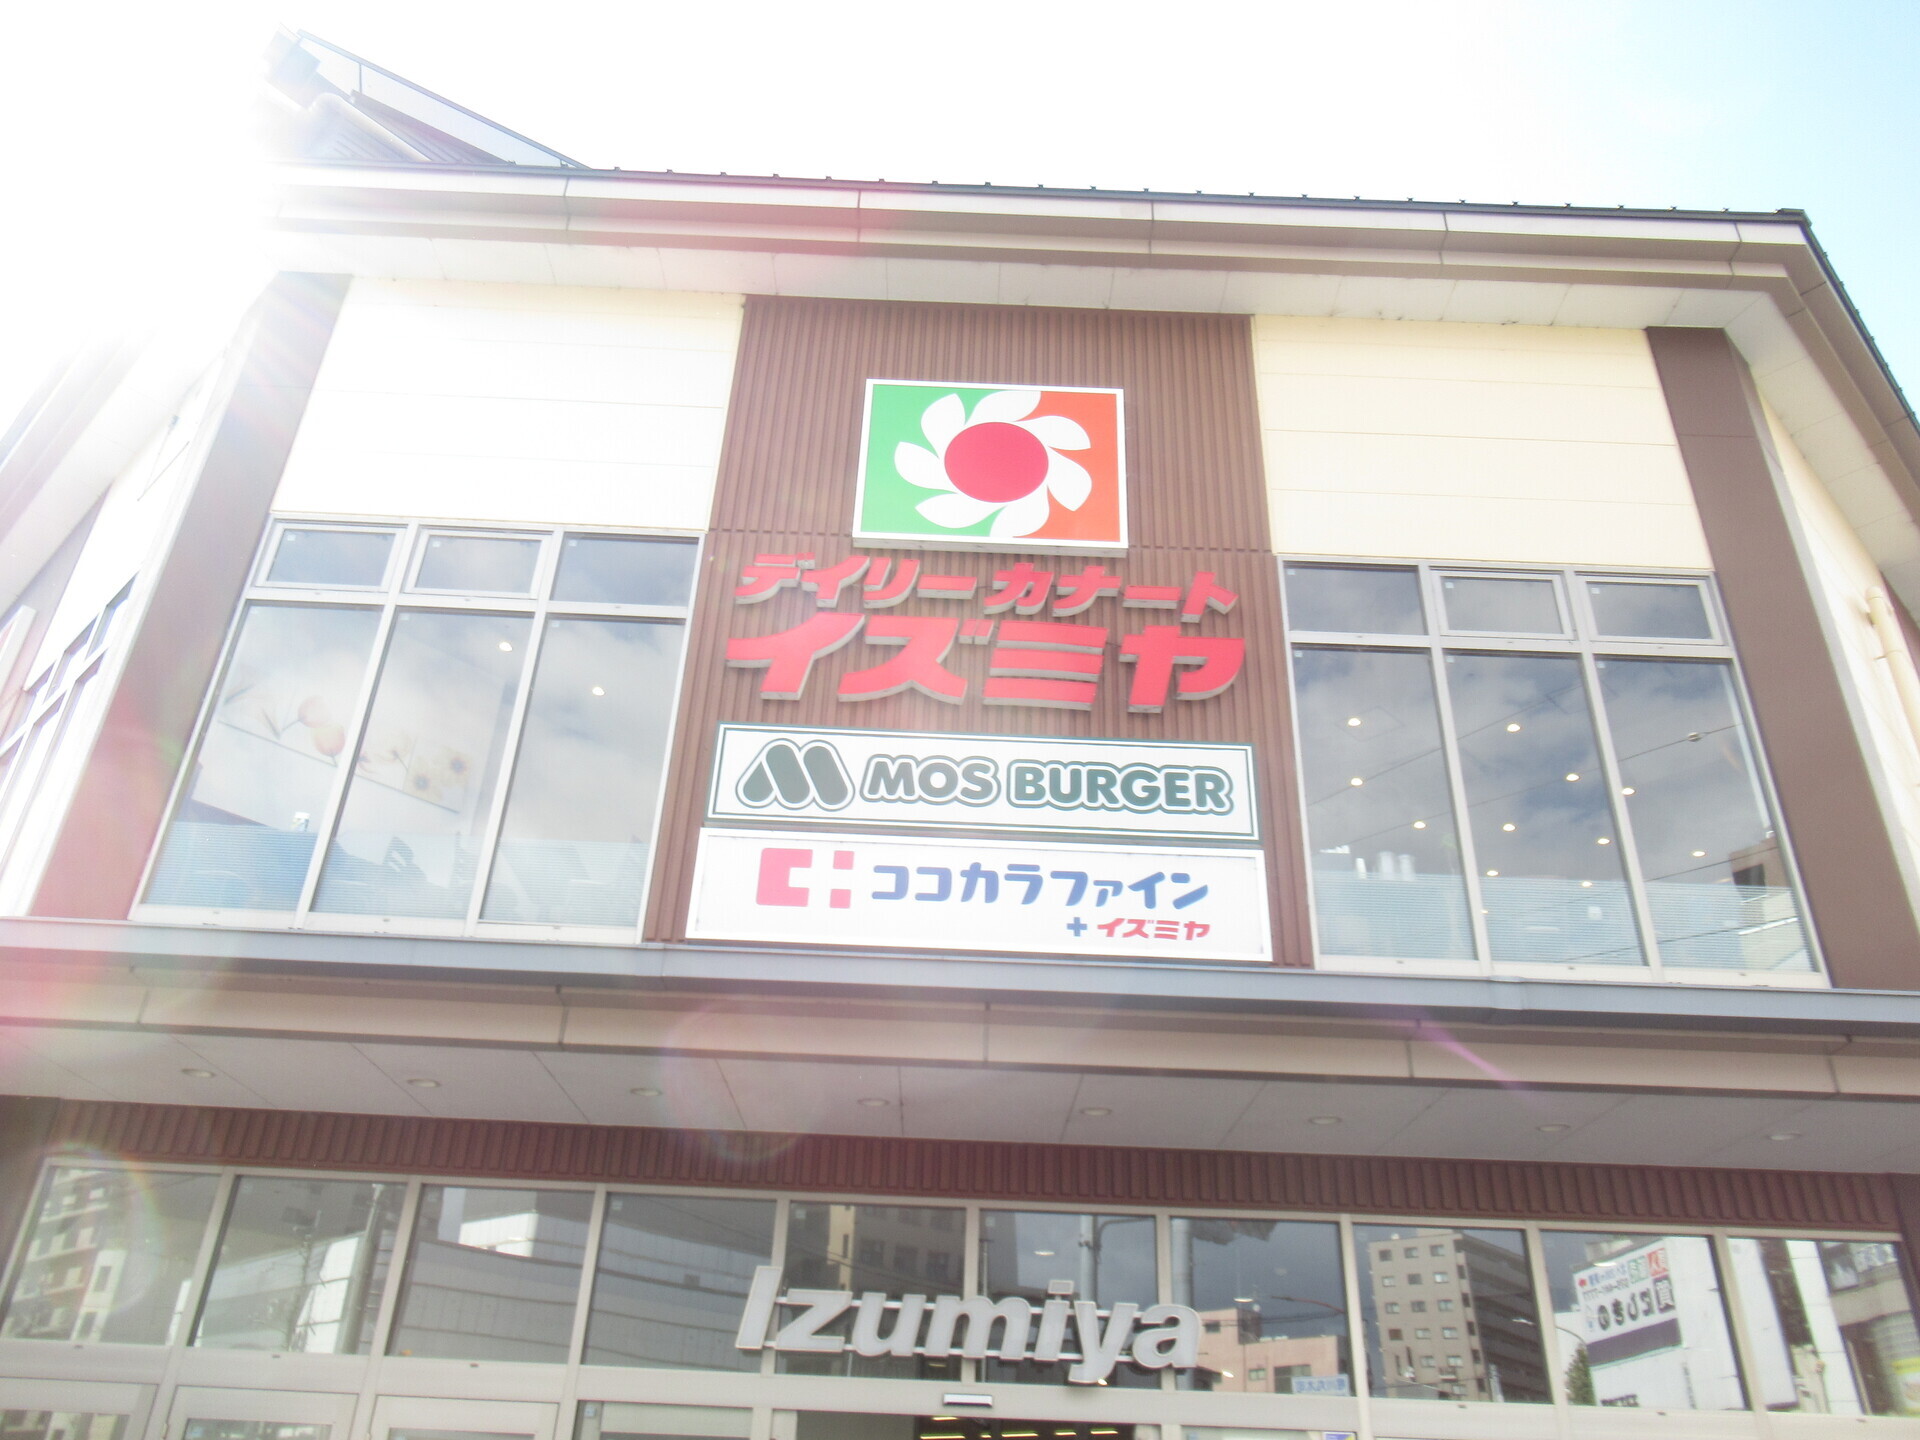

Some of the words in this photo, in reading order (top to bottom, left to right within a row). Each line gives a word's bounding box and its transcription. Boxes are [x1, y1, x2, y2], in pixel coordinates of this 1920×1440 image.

[734, 553, 1240, 623] デイリーカナート
[725, 611, 1246, 713] イズミヤ
[866, 756, 998, 804] MOS
[1012, 762, 1233, 811] BURGER
[872, 861, 1209, 910] ココカラファイン
[1097, 917, 1211, 940] イズミヤ
[735, 1265, 1200, 1384] Izumiya
